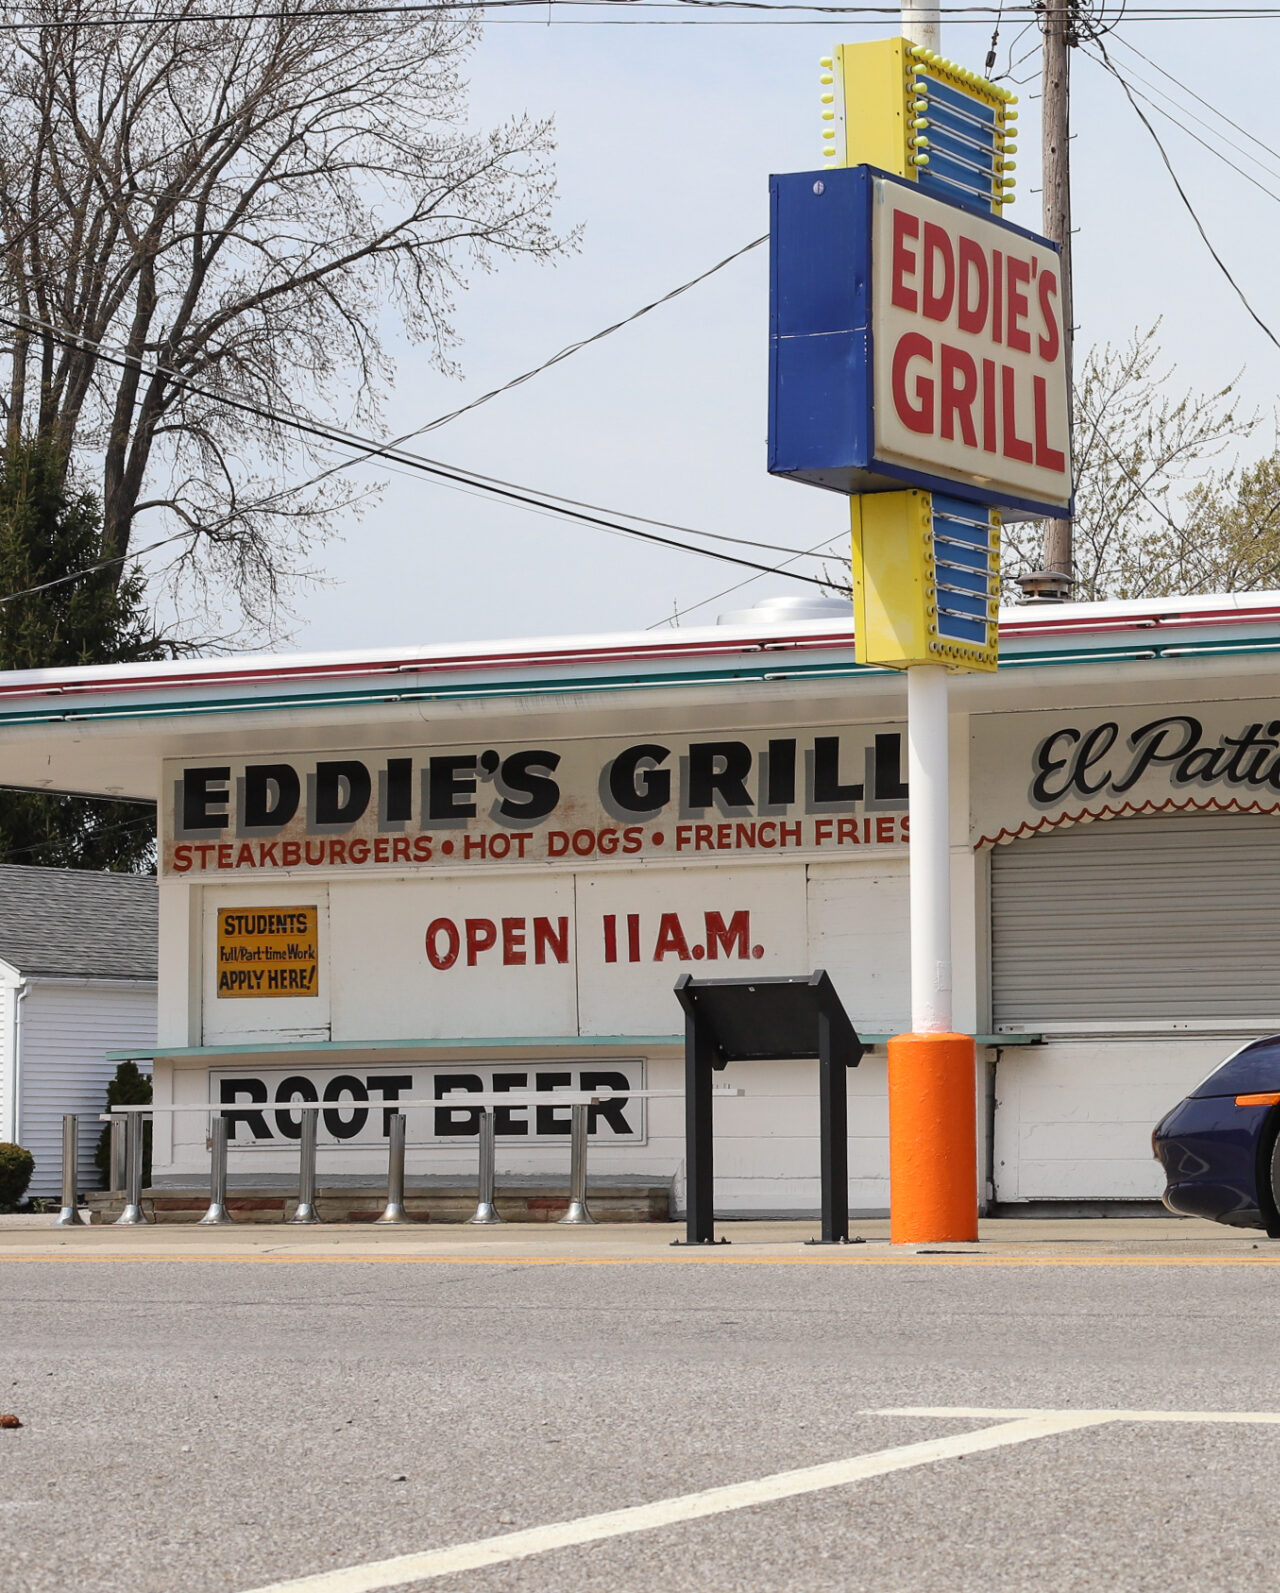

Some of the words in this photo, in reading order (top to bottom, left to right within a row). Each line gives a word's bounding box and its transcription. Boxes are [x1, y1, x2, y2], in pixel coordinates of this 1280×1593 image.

[891, 208, 1060, 363] EDDIE'S
[891, 331, 1066, 473] GRILL
[180, 749, 562, 833] EDDIE'S
[606, 732, 910, 815] GRILL
[1032, 721, 1119, 803] El
[172, 835, 433, 873] STEAKBURGERS
[463, 832, 534, 860] HOT
[547, 826, 644, 858] DOGS
[675, 820, 802, 851] FRENCH
[224, 913, 308, 936] STUDENTS
[287, 944, 316, 960] Work
[425, 917, 570, 971] OPEN
[652, 910, 765, 962] A.M.
[219, 970, 265, 990] APPLY
[267, 965, 316, 990] HERE!
[220, 1075, 414, 1140] ROOT
[433, 1071, 634, 1137] BEER
